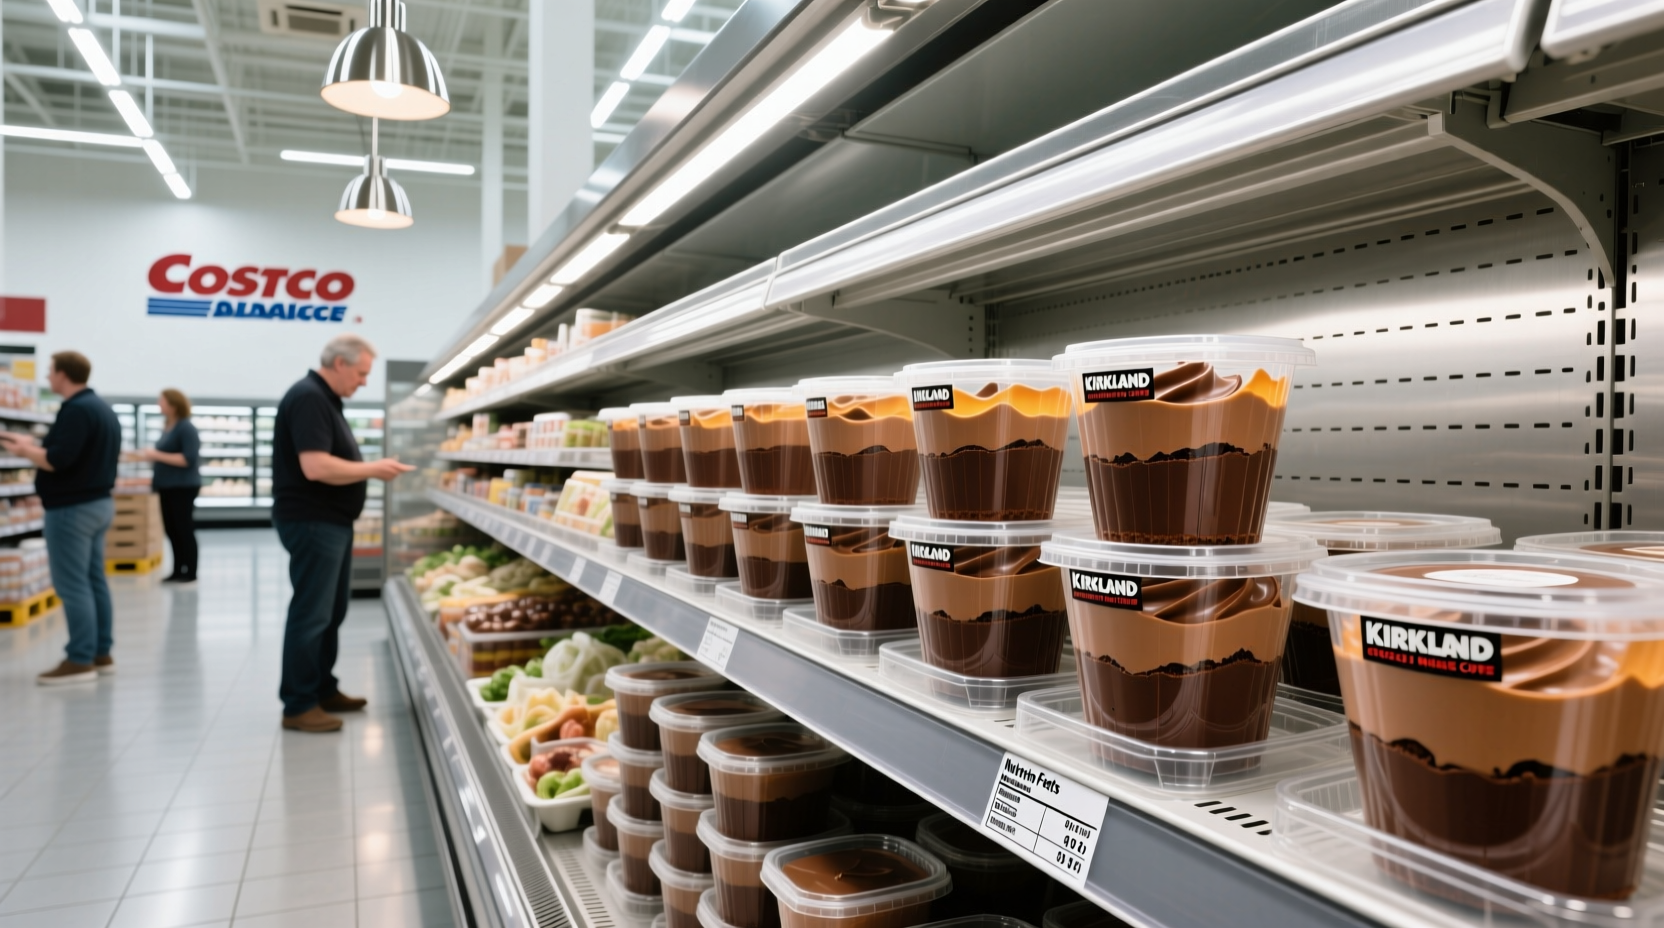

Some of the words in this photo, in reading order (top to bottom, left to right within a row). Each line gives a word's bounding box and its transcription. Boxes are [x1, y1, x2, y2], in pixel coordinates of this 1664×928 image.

[148, 253, 355, 301] COSTCO
[1084, 372, 1151, 392] KIRKLAND
[1071, 571, 1138, 597] KIRKLAND
[1365, 620, 1494, 662] KIRKLAND
